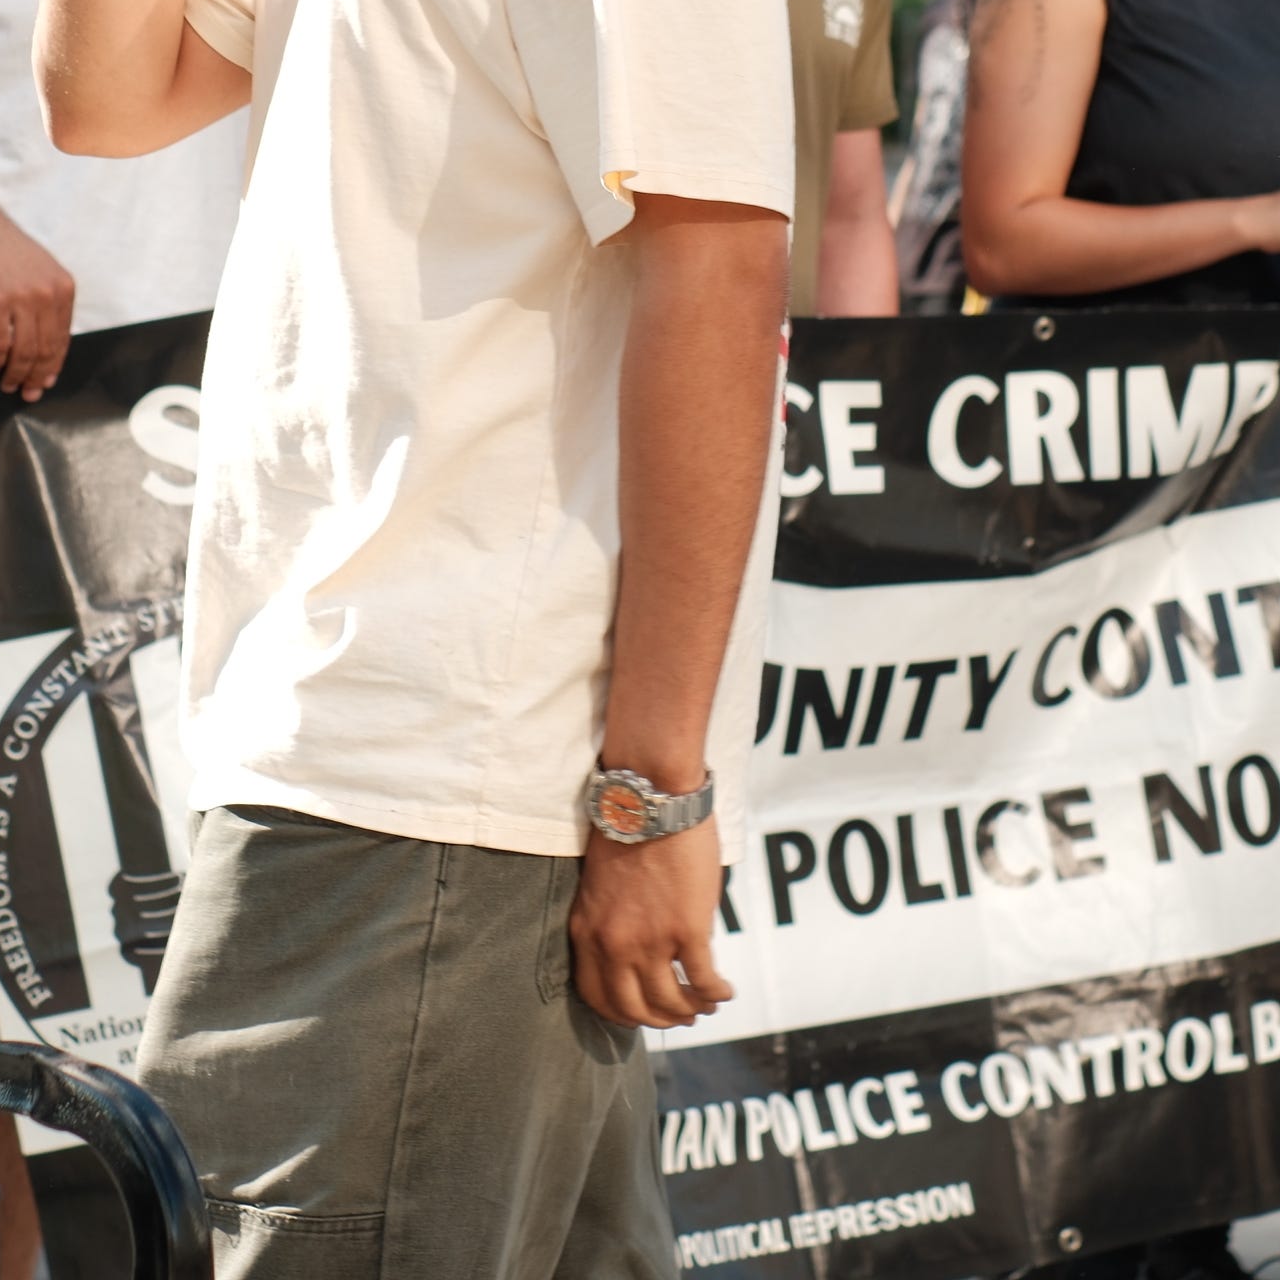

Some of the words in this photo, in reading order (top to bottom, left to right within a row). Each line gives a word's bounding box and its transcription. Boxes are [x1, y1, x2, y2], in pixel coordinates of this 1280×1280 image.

[3, 616, 129, 761] CONSTANT
[765, 786, 1106, 926] POLICE
[742, 1070, 932, 1162] POLICE
[940, 1013, 1248, 1122] CONTROL
